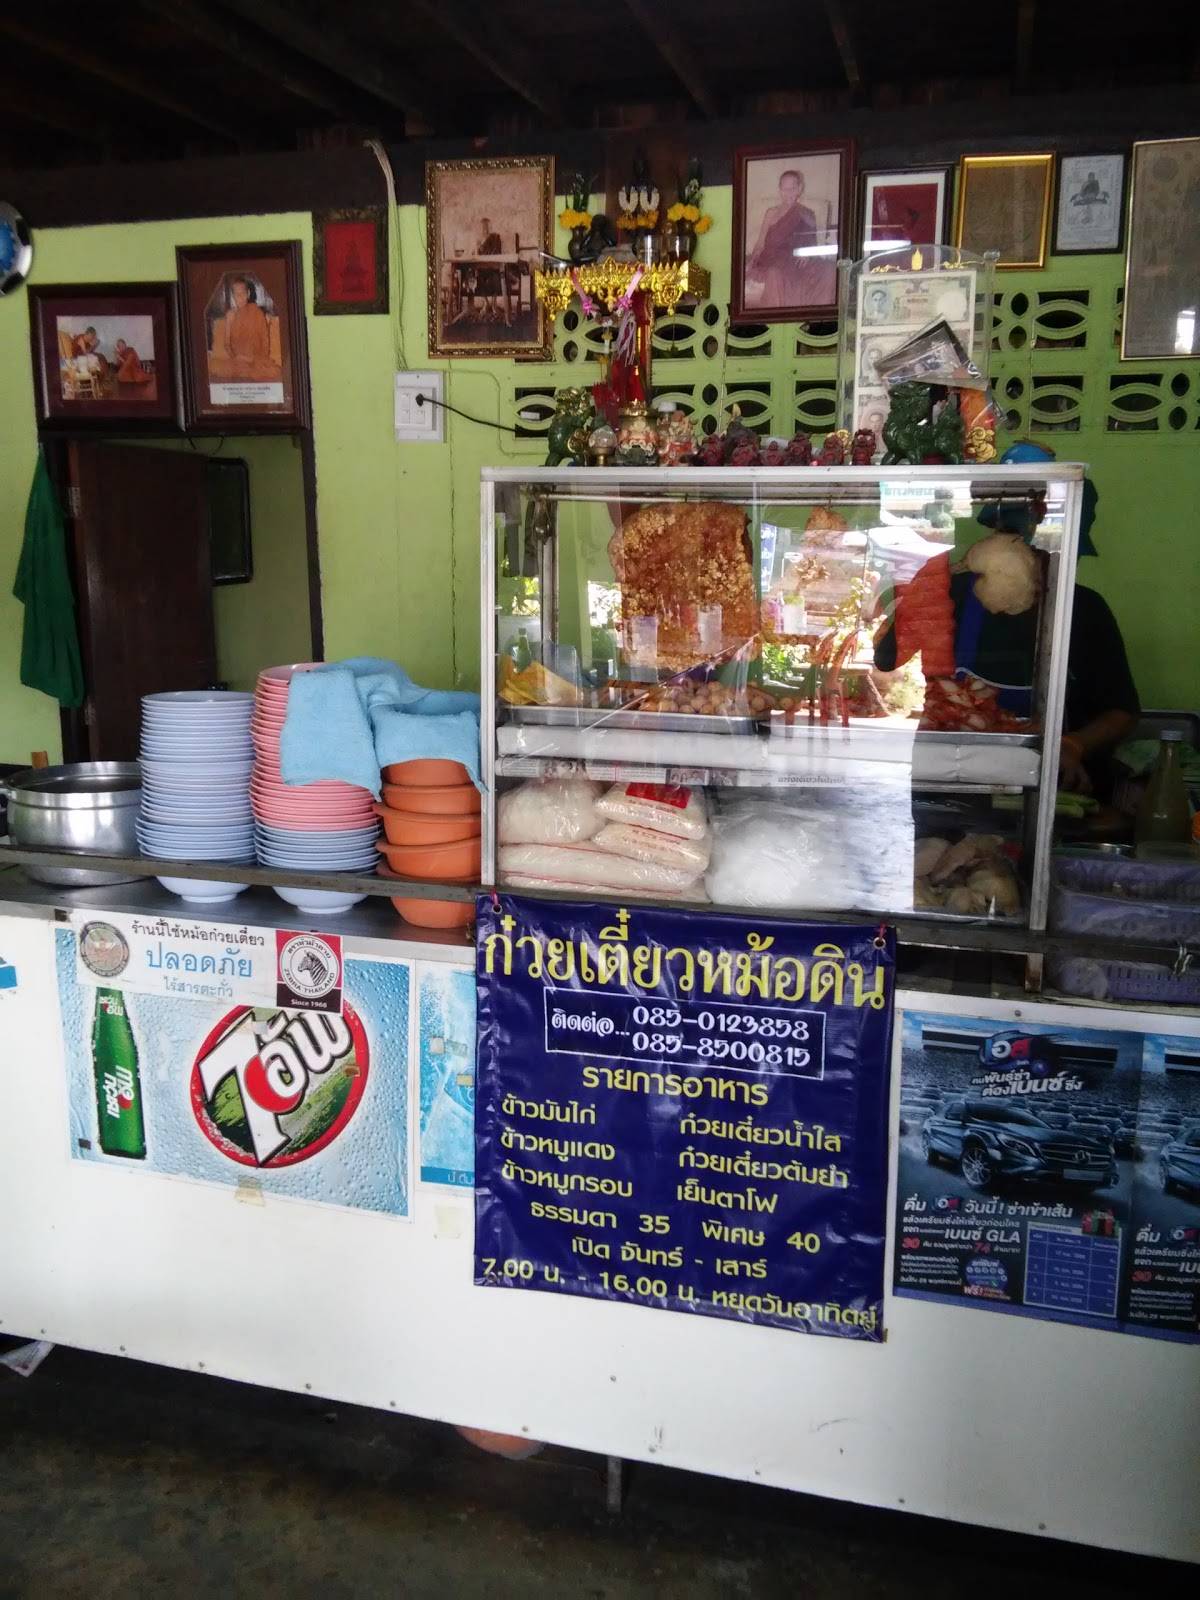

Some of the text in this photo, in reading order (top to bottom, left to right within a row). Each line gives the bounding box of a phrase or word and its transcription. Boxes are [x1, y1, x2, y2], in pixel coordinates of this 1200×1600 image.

[131, 918, 265, 946] ร้านนี้ใช้หม้อก๋วยเตี๋ยว
[146, 942, 253, 978] ปลอดภัย
[484, 908, 885, 1010] ก๋วยเตี๋ยวหม้อดิน
[163, 976, 234, 997] ไร้สารตะกั่ว
[633, 1006, 810, 1041] 085-0123858
[632, 1032, 811, 1067] 085-8500815
[582, 1066, 769, 1105] รายการอาหาร
[502, 1093, 596, 1124] ข้าวมันไก่
[501, 1127, 615, 1162] ข้าวหมูแดง
[680, 1112, 842, 1152] ก๋วยเตี๋ยวน้ำใส
[501, 1159, 633, 1197] ข้าวหมูกรอบ
[679, 1145, 849, 1189] ก๋วยเตี๋ยวต้มยำ
[677, 1178, 779, 1213] เย็นตาโฟ
[904, 1193, 927, 1212] ดื่ม
[530, 1201, 821, 1254] ธรรมดา 35 พิเศษ 40
[985, 1230, 1021, 1244] GLA
[571, 1236, 610, 1259] เปิด
[620, 1241, 684, 1267] จันทร์
[715, 1258, 768, 1279] เสาร์
[1179, 1262, 1200, 1274] เบ
[481, 1258, 534, 1280] 7.00
[544, 1265, 566, 1285] น.
[599, 1271, 668, 1298] 16.00
[678, 1284, 701, 1305] น.
[712, 1290, 877, 1327] หยุดวันอาทิตย์
